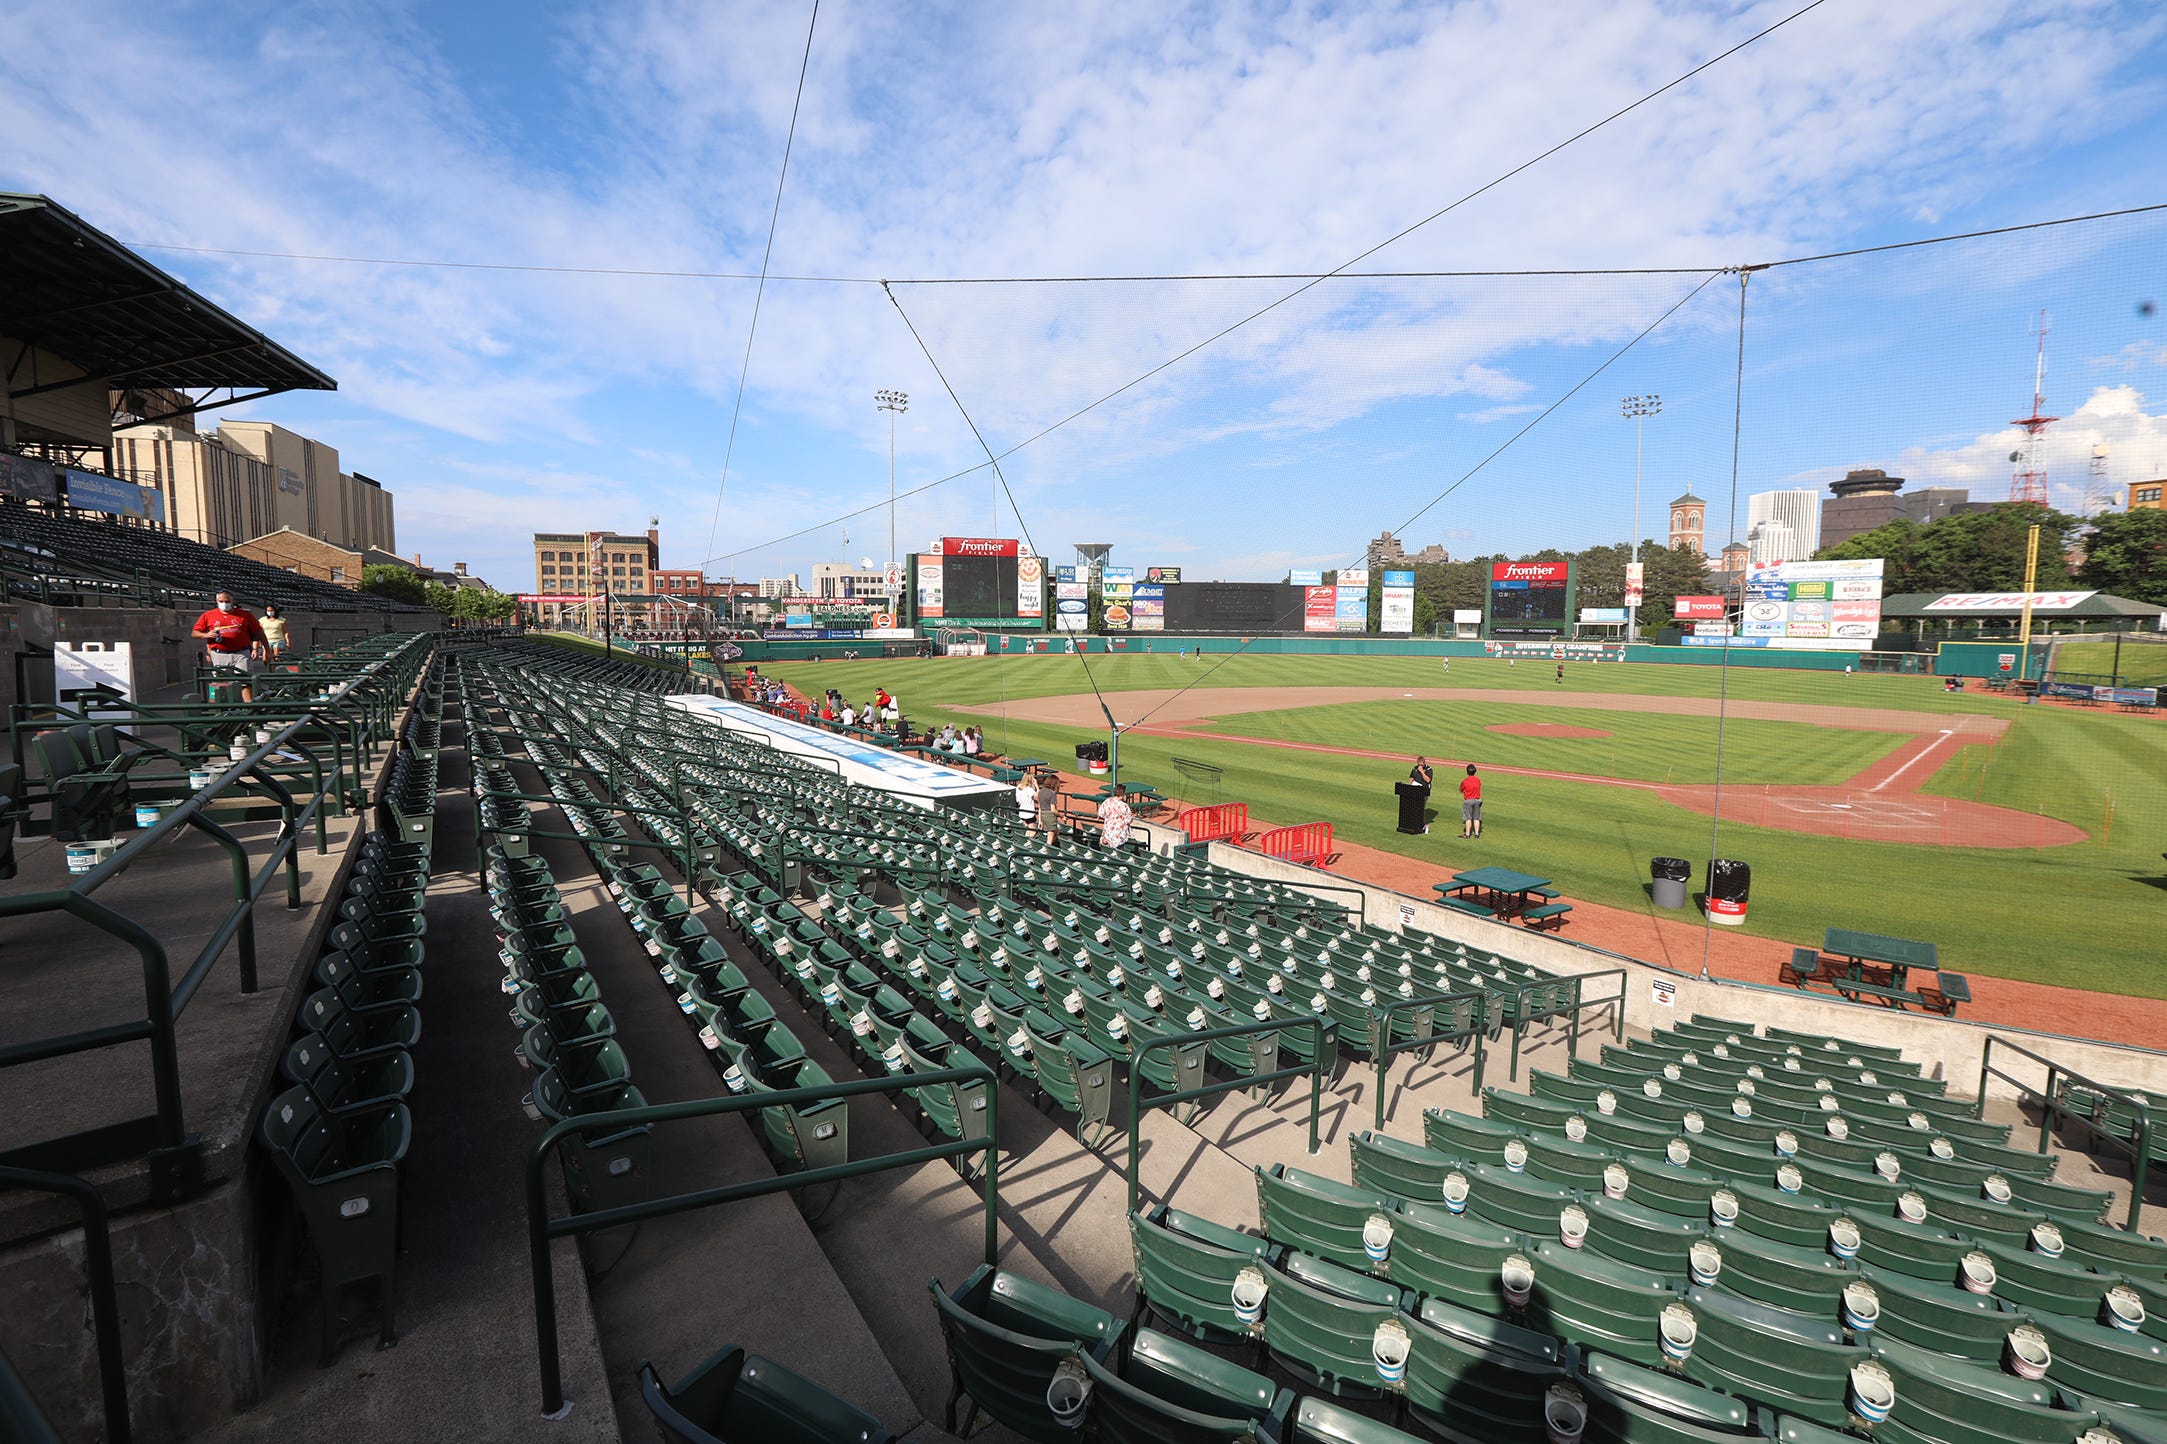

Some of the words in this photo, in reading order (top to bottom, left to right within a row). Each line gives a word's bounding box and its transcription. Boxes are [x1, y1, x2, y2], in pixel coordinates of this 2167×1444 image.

[70, 476, 103, 493] Invisible
[958, 540, 1004, 553] frontier
[1504, 564, 1555, 578] frontier
[1104, 583, 1131, 593] WM
